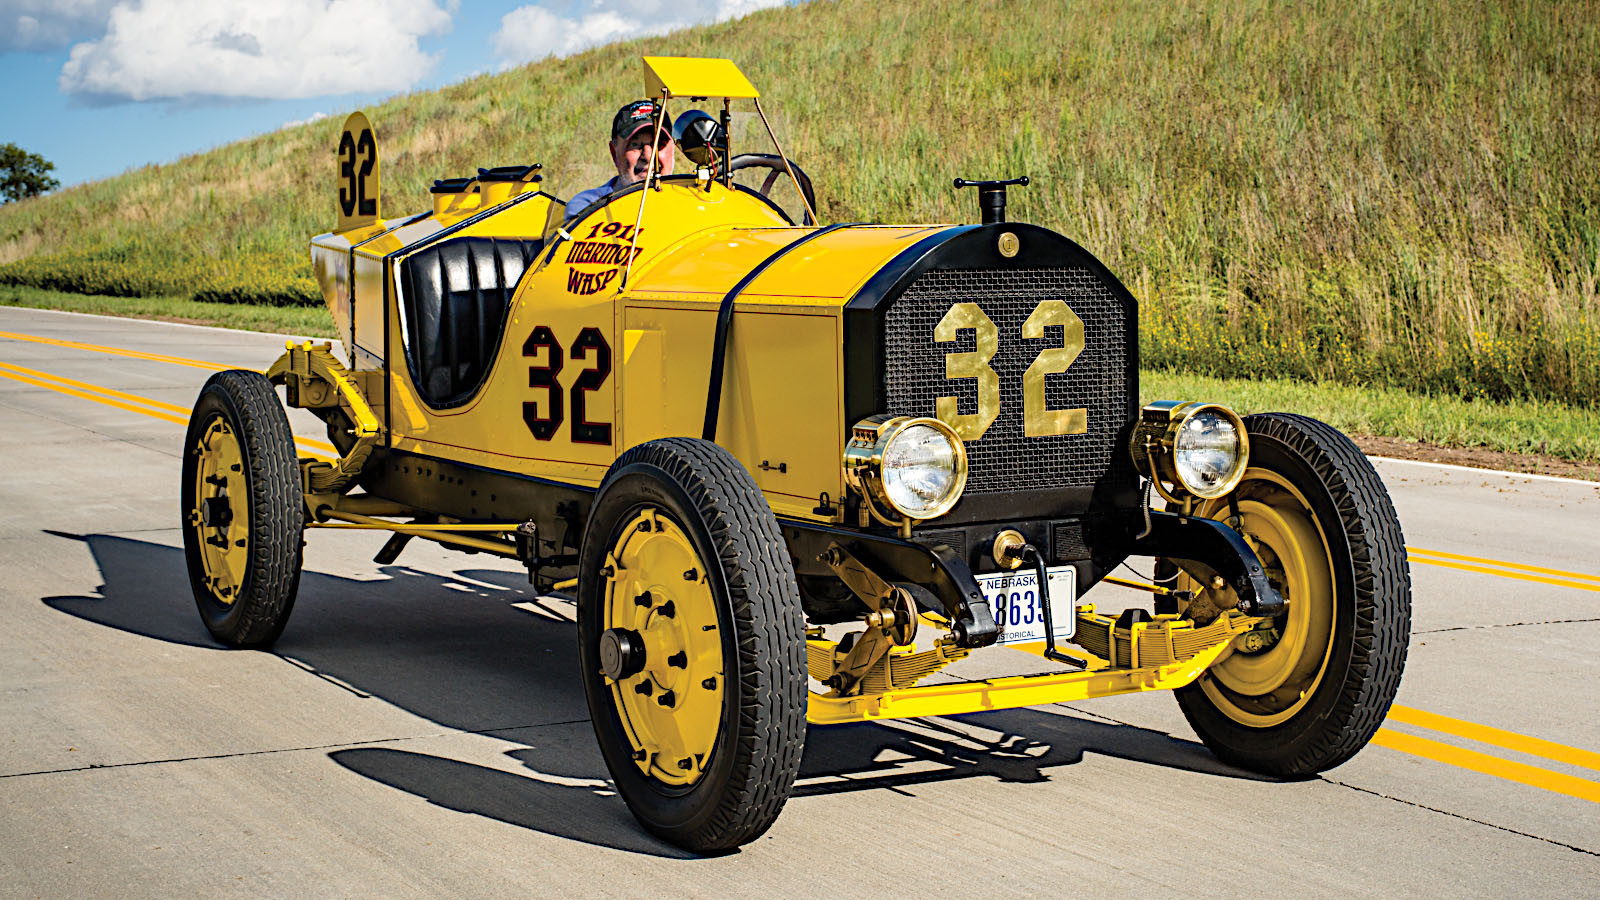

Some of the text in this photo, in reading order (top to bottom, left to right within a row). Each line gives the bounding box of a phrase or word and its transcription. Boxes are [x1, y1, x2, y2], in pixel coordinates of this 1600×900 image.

[338, 128, 377, 217] 32
[584, 221, 645, 244] 1911
[565, 240, 644, 267] MARMON
[567, 266, 619, 296] WASP
[933, 299, 1088, 442] 32
[522, 325, 612, 447] 32
[986, 575, 1040, 590] NEBRASK
[984, 590, 1045, 627] 863
[997, 630, 1036, 641] ISTORICAL
